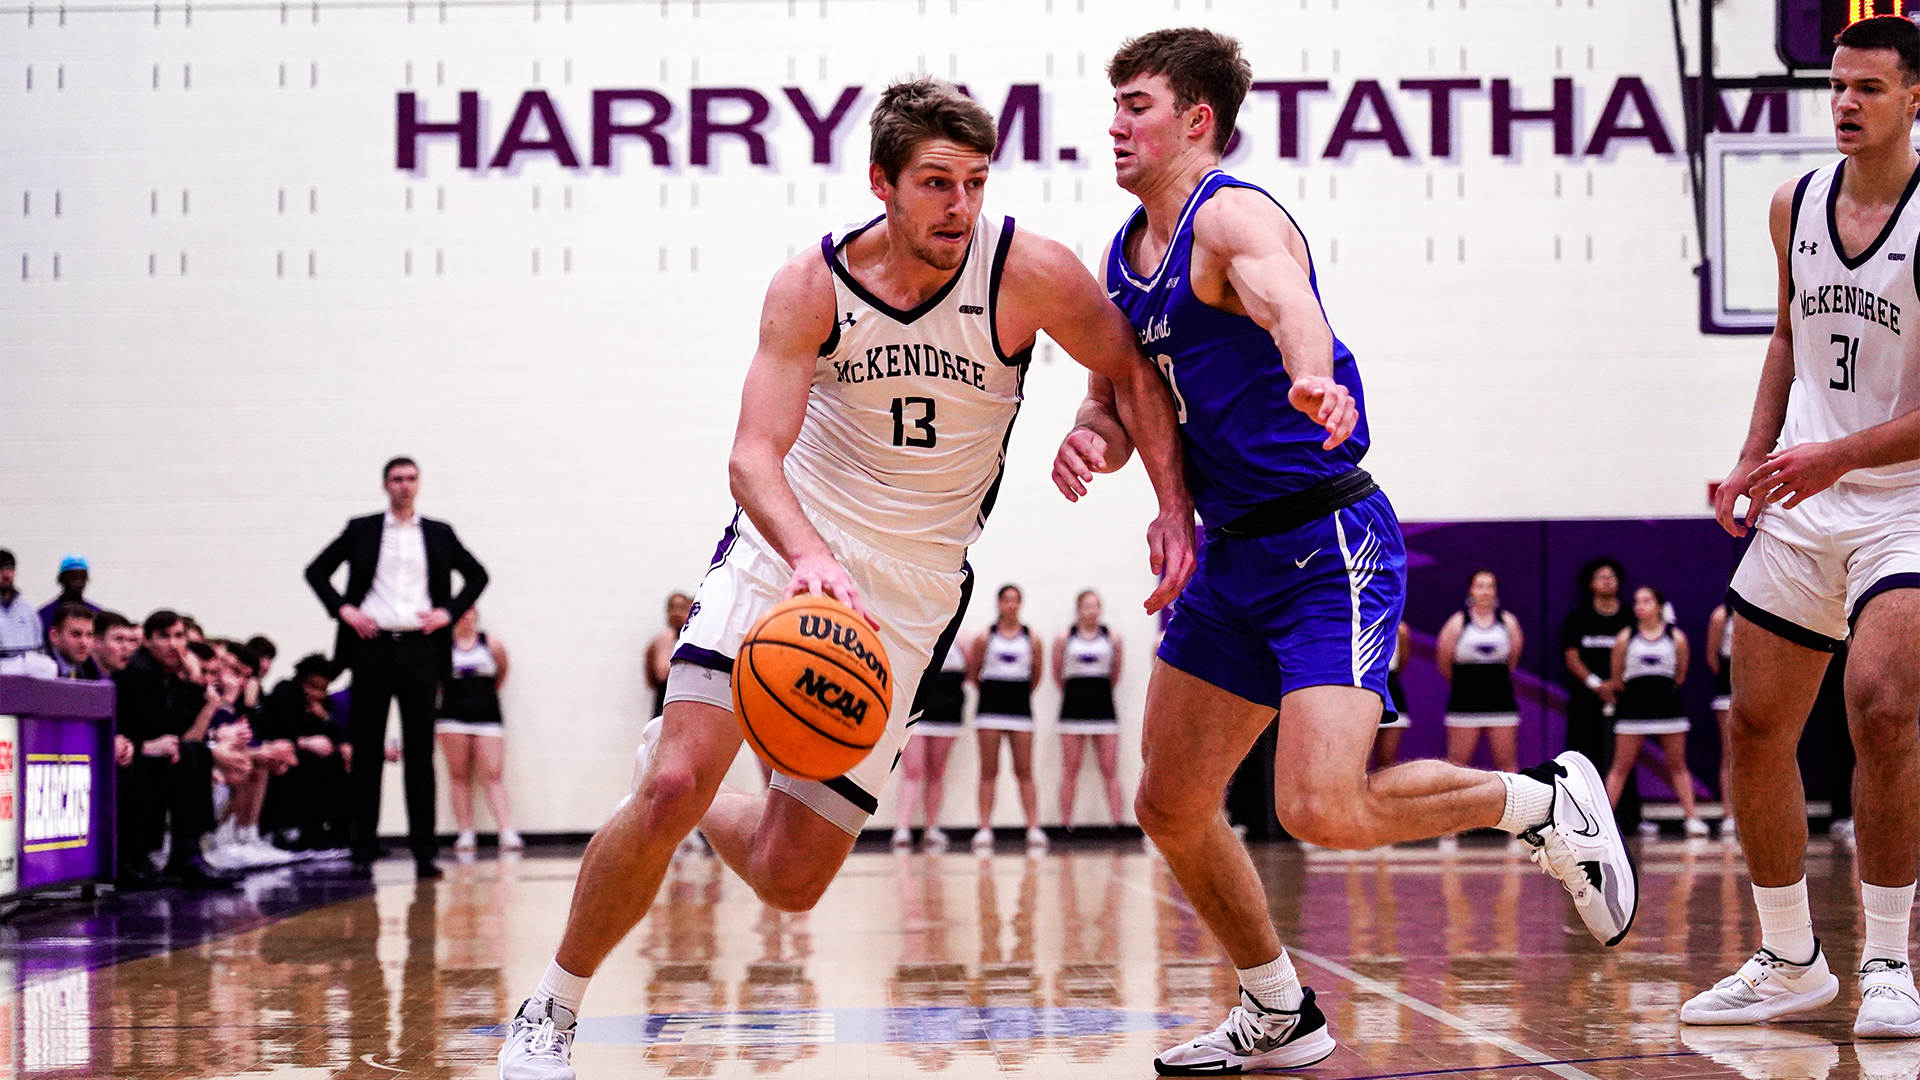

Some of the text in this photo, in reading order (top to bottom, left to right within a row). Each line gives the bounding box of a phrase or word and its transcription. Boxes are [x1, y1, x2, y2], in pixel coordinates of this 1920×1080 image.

[394, 85, 865, 169] HARRY
[1220, 76, 1790, 160] TATHAM
[1829, 333, 1860, 394] 31
[889, 396, 937, 449] 13
[798, 614, 889, 693] Wilson
[794, 667, 868, 726] NCAA
